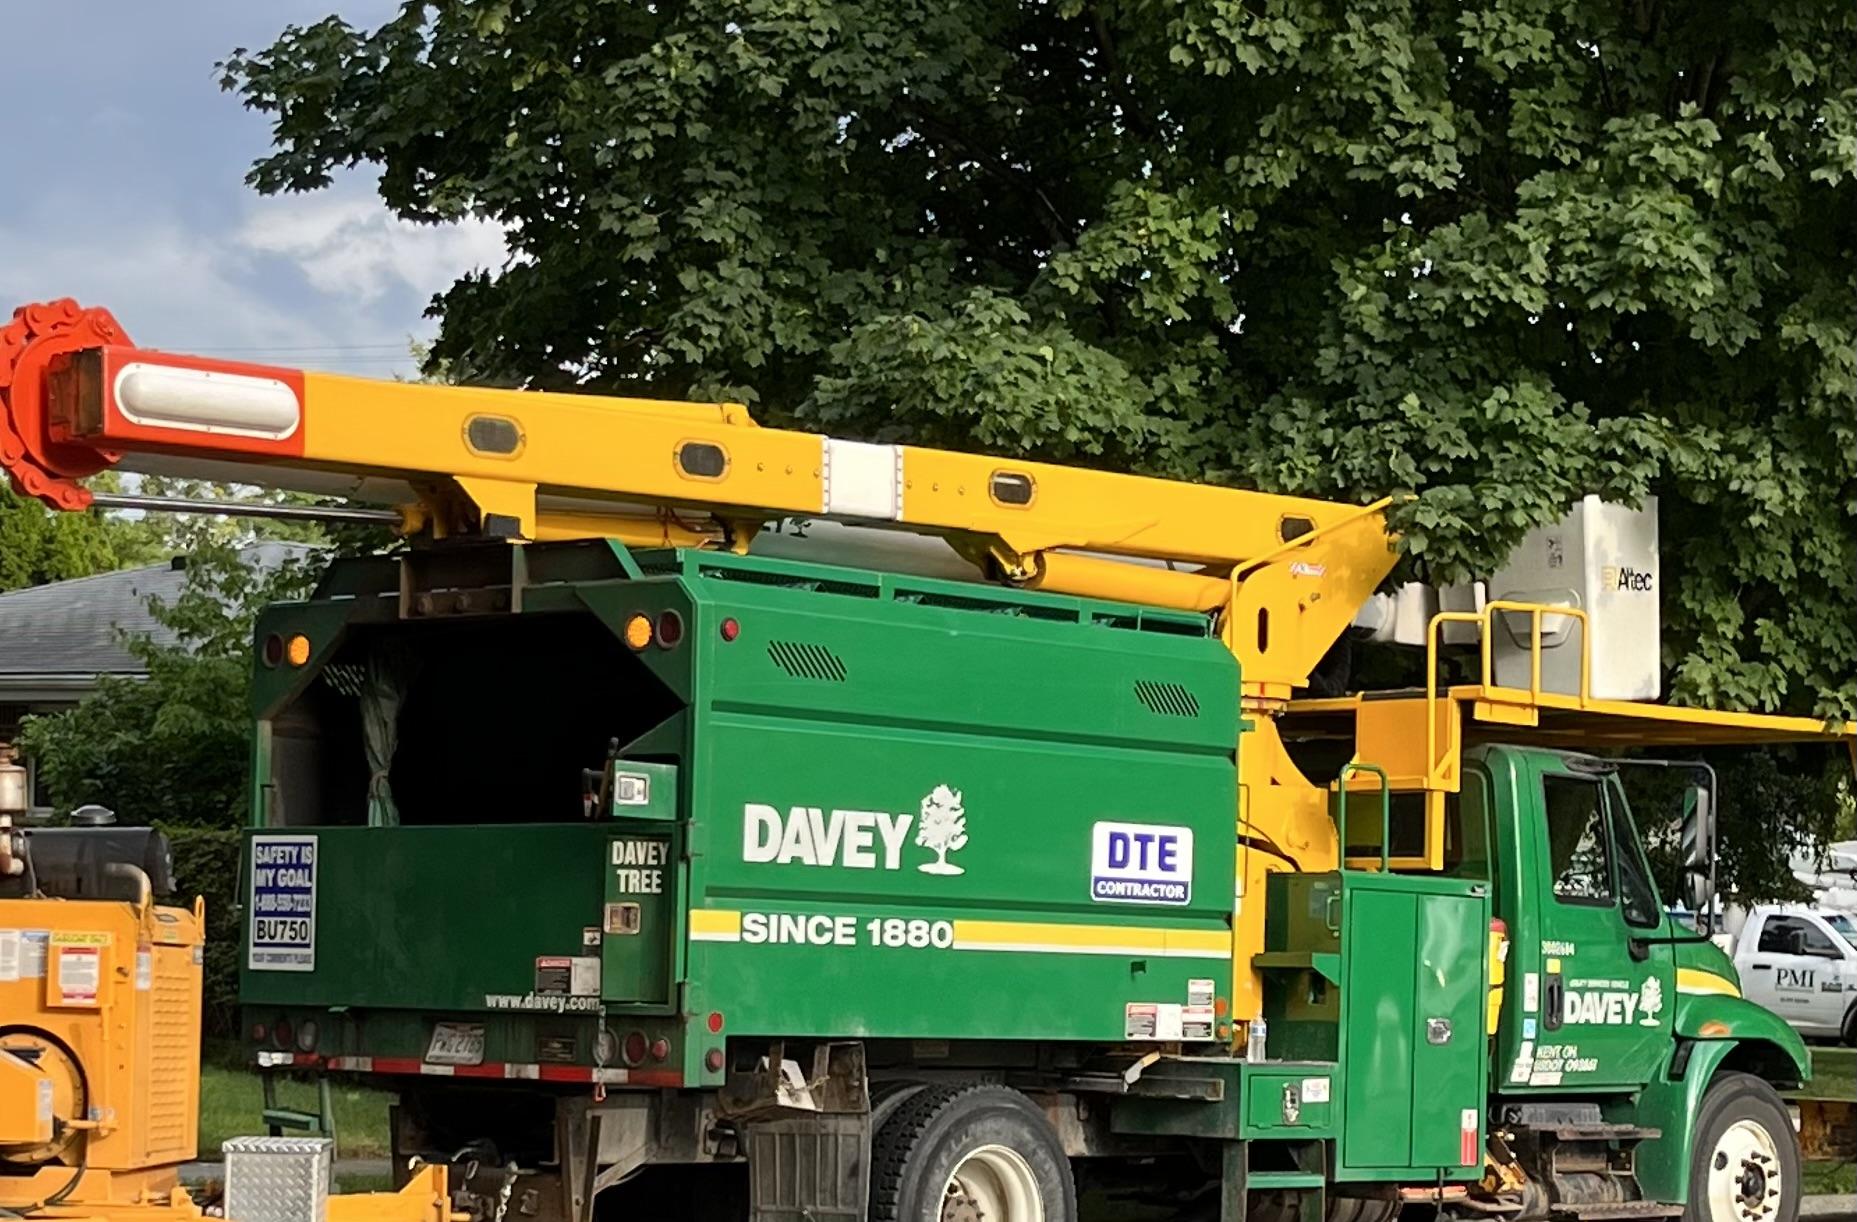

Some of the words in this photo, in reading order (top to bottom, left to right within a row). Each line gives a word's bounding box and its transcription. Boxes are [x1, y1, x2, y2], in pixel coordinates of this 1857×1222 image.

[1618, 567, 1652, 591] Altec
[743, 803, 914, 870] DAVEY
[256, 845, 299, 864] SAFETY
[301, 845, 313, 864] IS
[612, 841, 670, 865] DAVEY
[1108, 831, 1177, 872] DTE
[255, 868, 276, 887] MY
[277, 868, 313, 887] GOAL
[616, 870, 662, 893] TREE
[1097, 881, 1185, 899] CONTRACTOR
[257, 920, 308, 940] BU750
[742, 913, 857, 945] SINCE
[867, 918, 954, 948] 1880
[1777, 968, 1816, 987] PMI
[485, 991, 601, 1013] www.davey.com
[1563, 991, 1639, 1024] DAVEY
